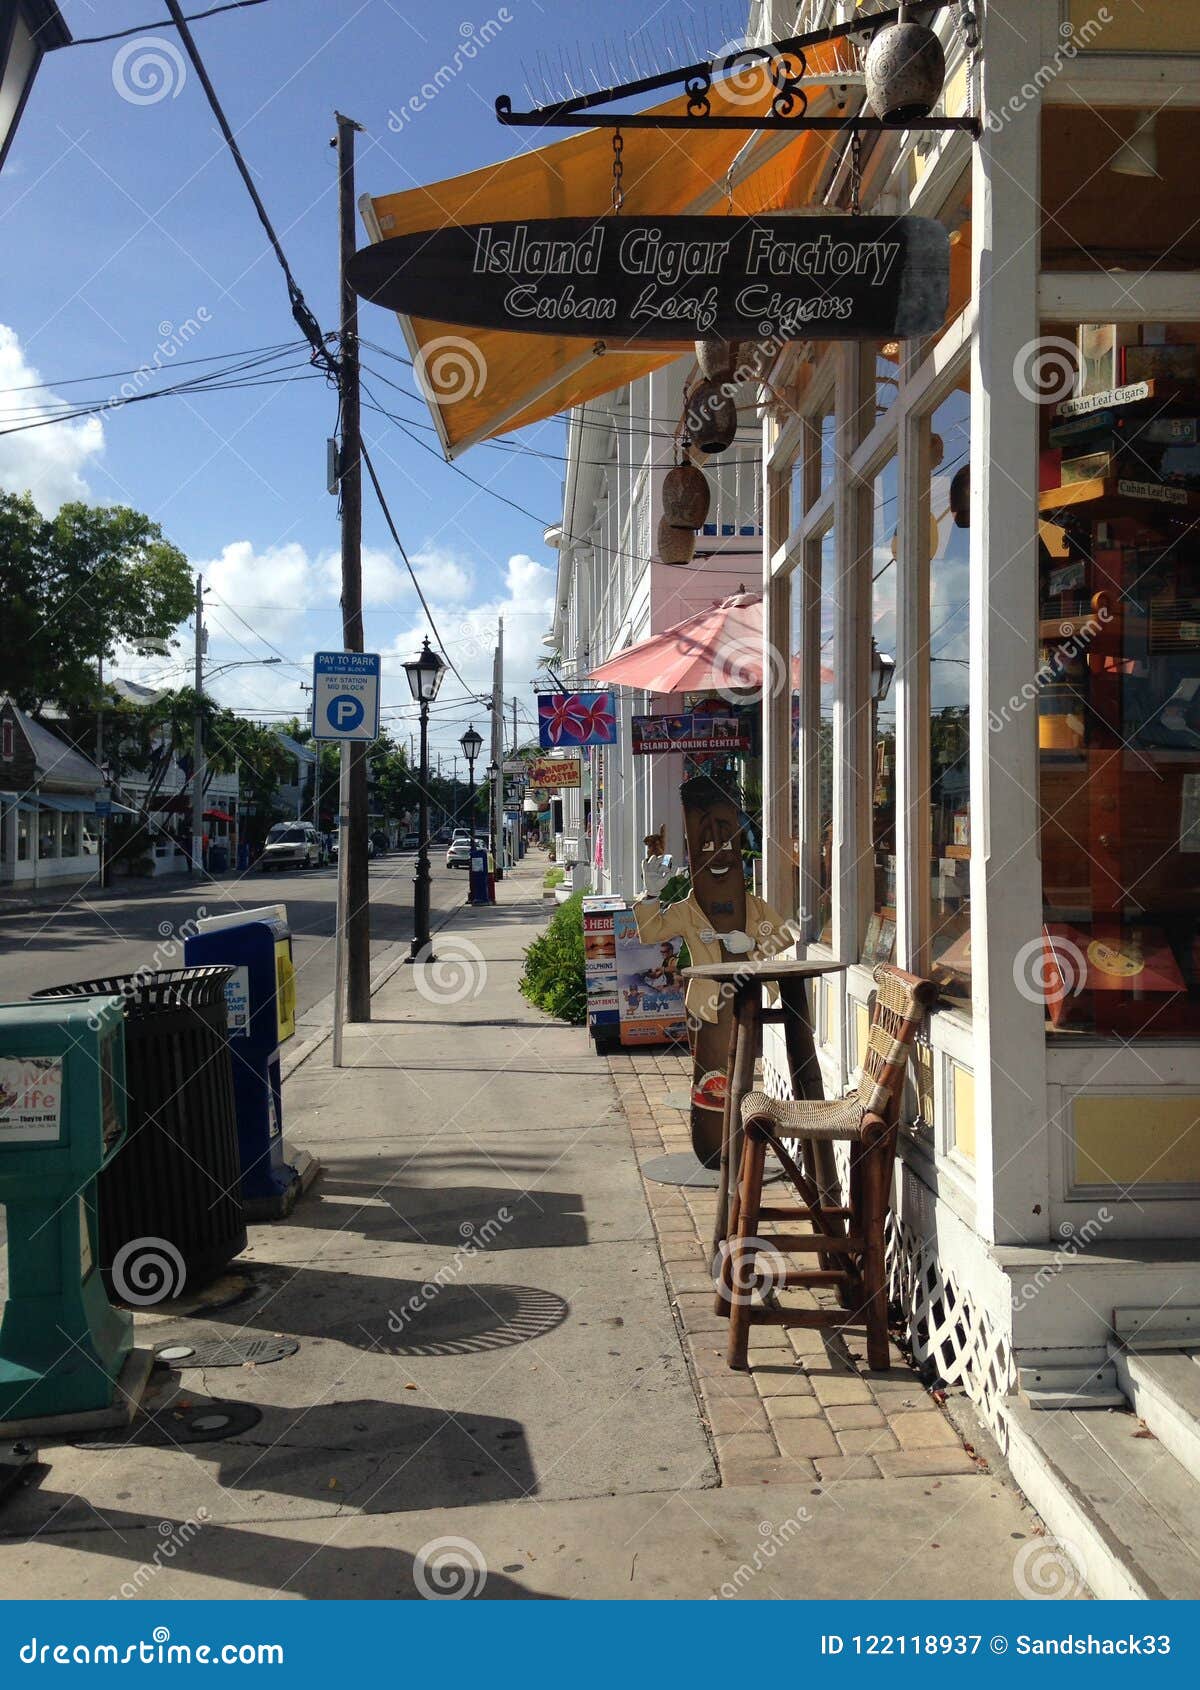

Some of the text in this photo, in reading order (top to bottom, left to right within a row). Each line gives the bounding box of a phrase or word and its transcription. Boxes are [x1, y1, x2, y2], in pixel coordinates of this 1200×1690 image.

[473, 226, 900, 285] Island Cigar Factory
[504, 283, 854, 331] Cuban Leaf Cigars
[1060, 386, 1145, 415] Cuban Leaf Cigars
[319, 655, 375, 666] PAY TO PARK
[337, 701, 357, 725] P
[640, 738, 740, 750] ISLAND BOOKING CENTER
[538, 770, 578, 785] ROOSTER
[590, 918, 614, 930] HERE
